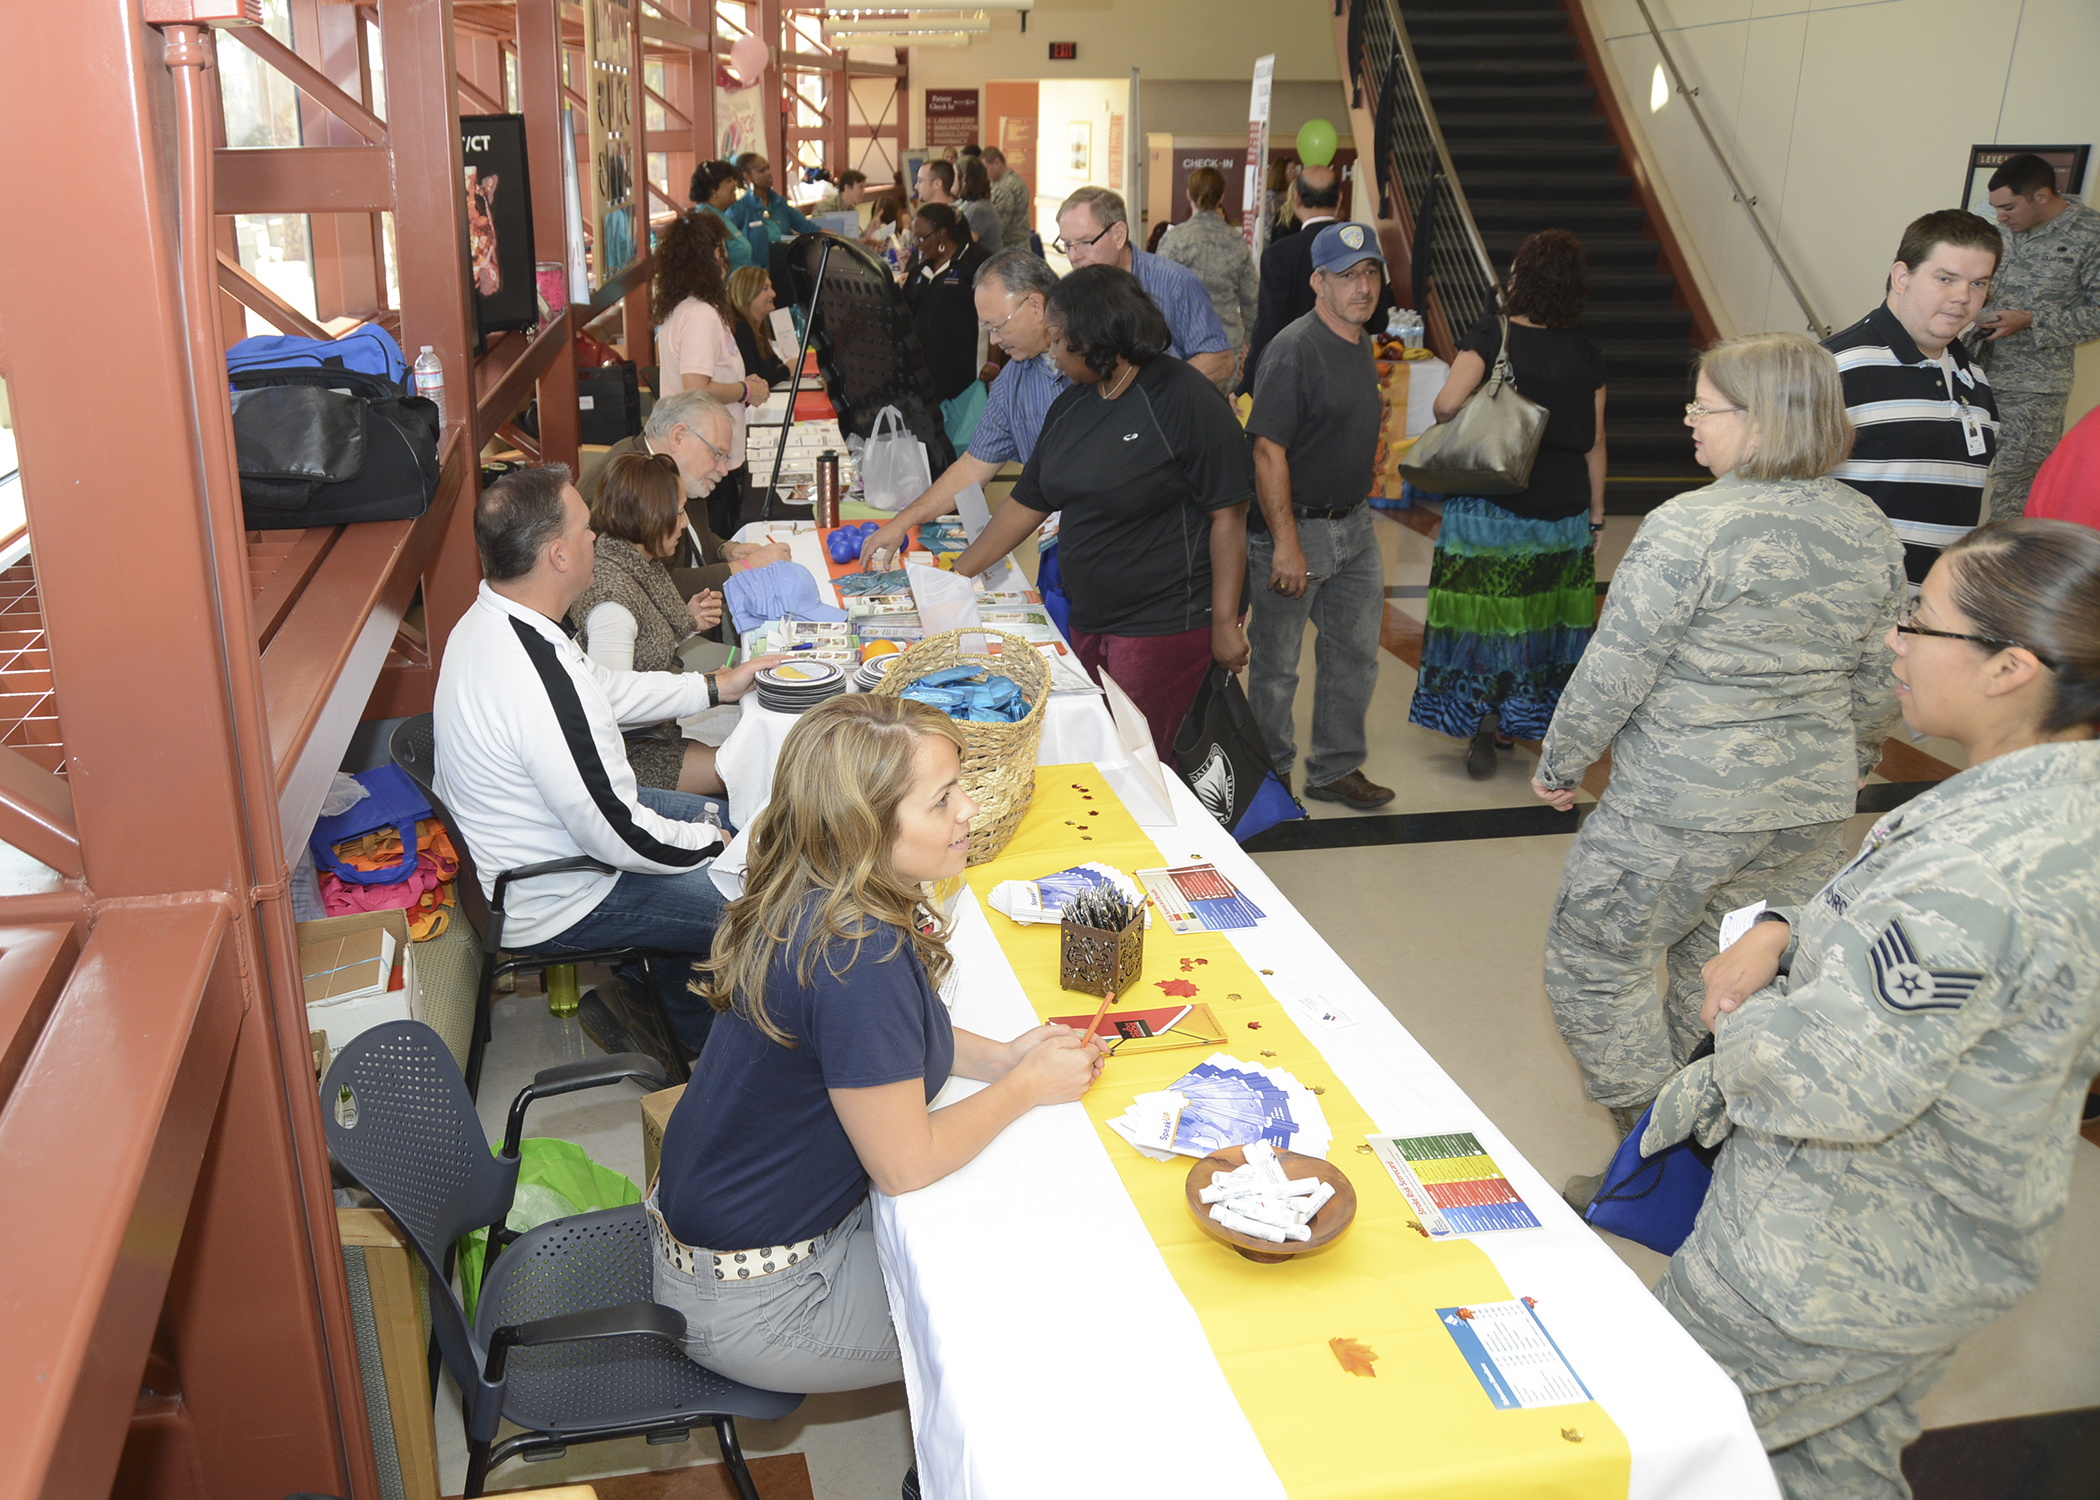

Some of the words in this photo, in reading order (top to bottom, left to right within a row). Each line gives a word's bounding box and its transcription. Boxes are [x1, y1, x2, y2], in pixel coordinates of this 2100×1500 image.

[1054, 42, 1073, 57] EXIT
[1182, 158, 1234, 169] CHECK-IN
[1386, 1160, 1408, 1187] Scorecard
[1411, 1194, 1428, 1216] Stroke
